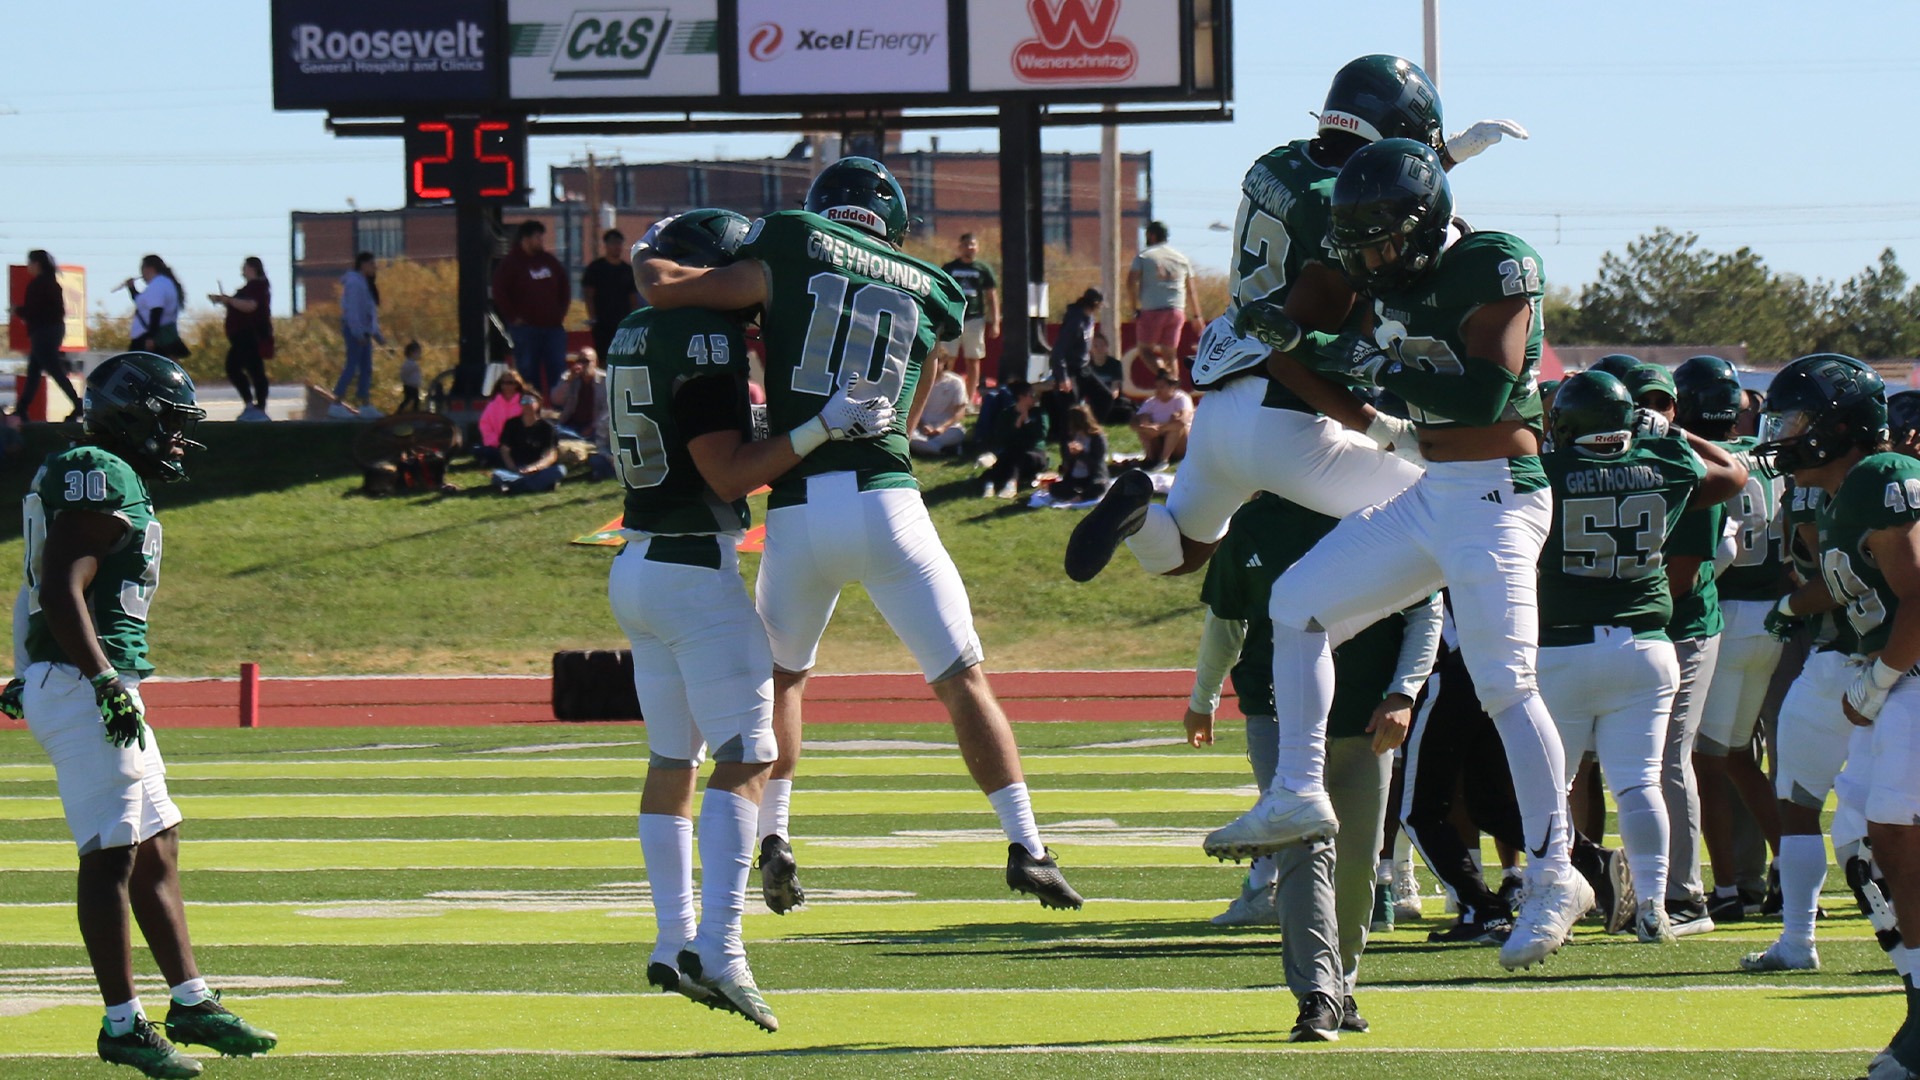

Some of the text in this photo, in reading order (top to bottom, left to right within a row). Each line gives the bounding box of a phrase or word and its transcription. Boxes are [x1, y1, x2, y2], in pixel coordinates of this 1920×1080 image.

[300, 20, 485, 60] Roosevelt
[567, 17, 655, 61] C&S
[796, 29, 937, 56] Xcel Energy
[1028, 0, 1120, 49] W
[301, 59, 485, 75] General Hospital and Clinics
[1018, 53, 1131, 70] Wienerschnitzel
[413, 122, 515, 198] 25
[827, 208, 876, 226] Riddell
[807, 230, 931, 297] GREYHOUNDS
[1498, 256, 1540, 296] 22
[687, 334, 730, 364] 45
[791, 271, 920, 402] 10
[64, 470, 107, 502] 30
[1566, 465, 1664, 494] GREYHOUNDS
[1884, 478, 1920, 513] 40
[1563, 493, 1667, 580] 53
